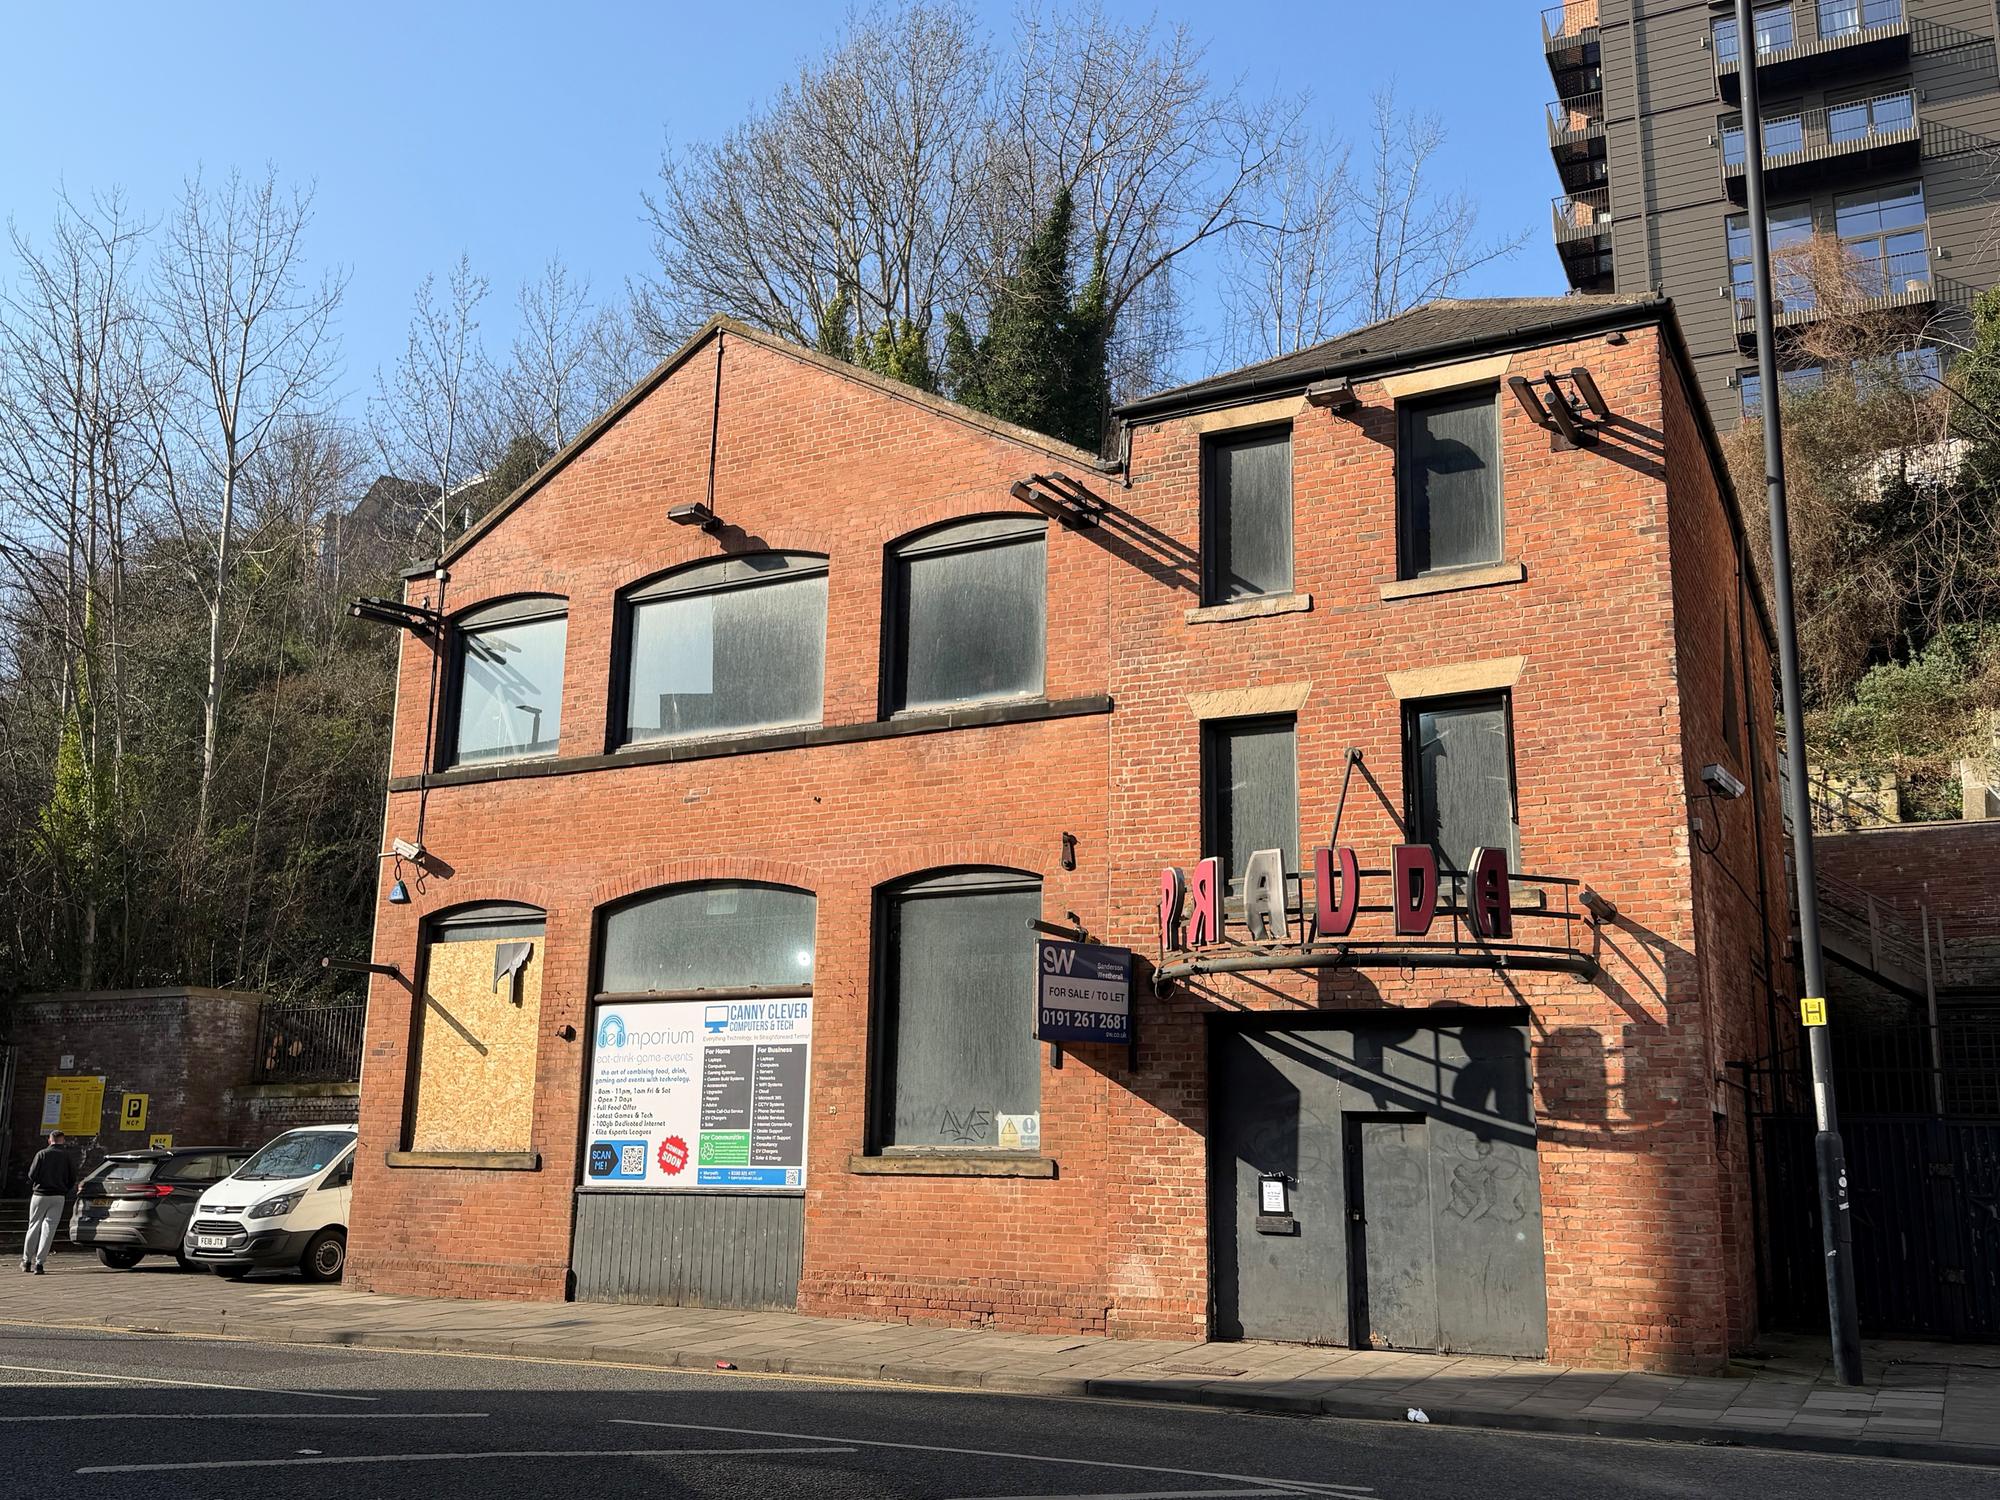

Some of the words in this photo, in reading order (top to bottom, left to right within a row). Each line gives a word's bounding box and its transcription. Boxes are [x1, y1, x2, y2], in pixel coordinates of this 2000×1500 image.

[1044, 945, 1075, 974] SW
[1097, 962, 1123, 970] Sanderson
[1049, 987, 1066, 996] FOR
[1068, 989, 1089, 999] SALE
[1097, 992, 1108, 1000] TO
[1110, 994, 1125, 1003] LET
[730, 1004, 765, 1020] CANNY
[768, 1003, 808, 1019] CLEVER
[1805, 1002, 1822, 1023] H
[729, 1020, 768, 1031] COMPUTERS
[770, 1021, 775, 1030] &
[777, 1020, 793, 1030] TECH
[1042, 1010, 1070, 1026] 0191
[1074, 1012, 1095, 1027] 261
[1100, 1014, 1126, 1030] 2681
[607, 1028, 694, 1050] emporium
[656, 1067, 670, 1075] food,
[130, 1100, 139, 1116] P
[592, 1151, 611, 1159] SCAN
[666, 1143, 684, 1157] COMING
[595, 1161, 607, 1170] ME!
[662, 1152, 682, 1168] SOON
[213, 1238, 223, 1246] JTX
